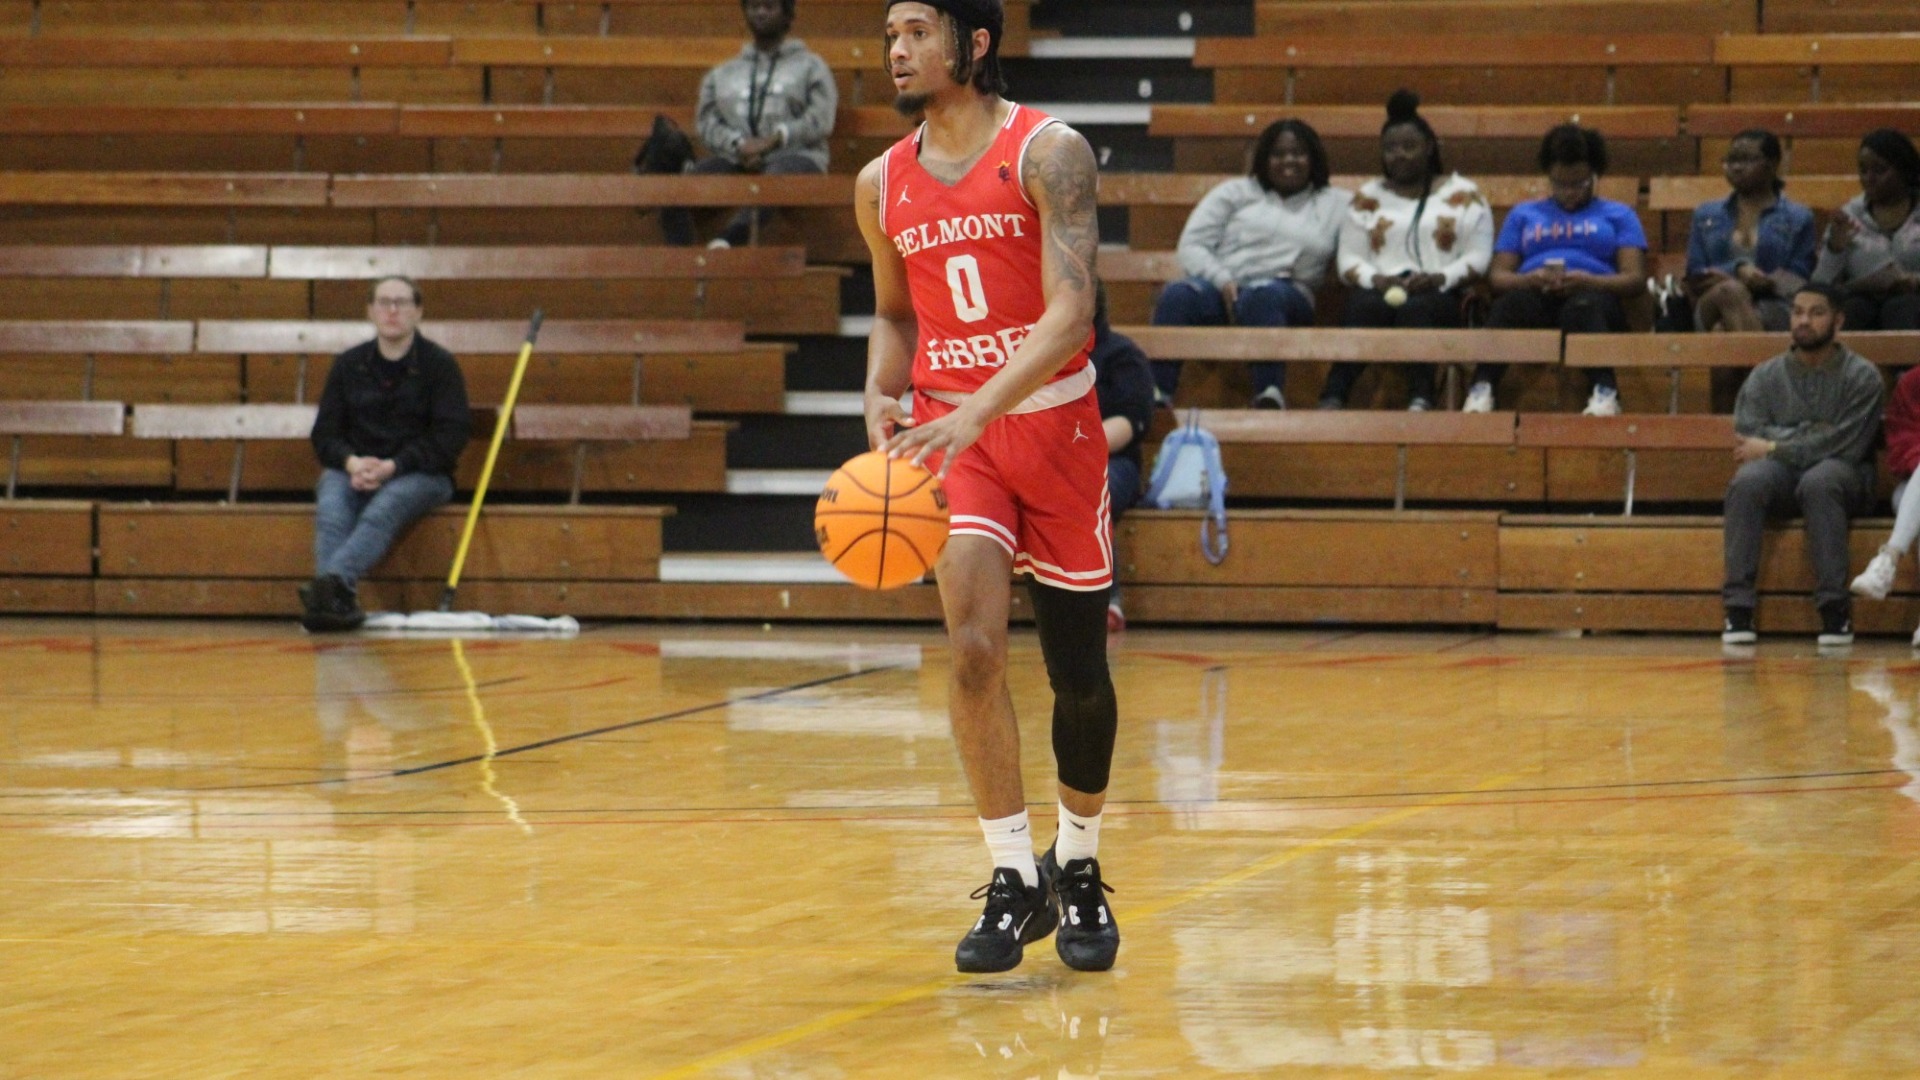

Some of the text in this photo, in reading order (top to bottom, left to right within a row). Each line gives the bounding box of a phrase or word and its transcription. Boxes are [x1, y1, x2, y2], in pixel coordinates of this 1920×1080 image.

[893, 213, 1026, 258] BELMONT
[945, 253, 989, 323] 0
[926, 323, 1037, 371] ABBE
